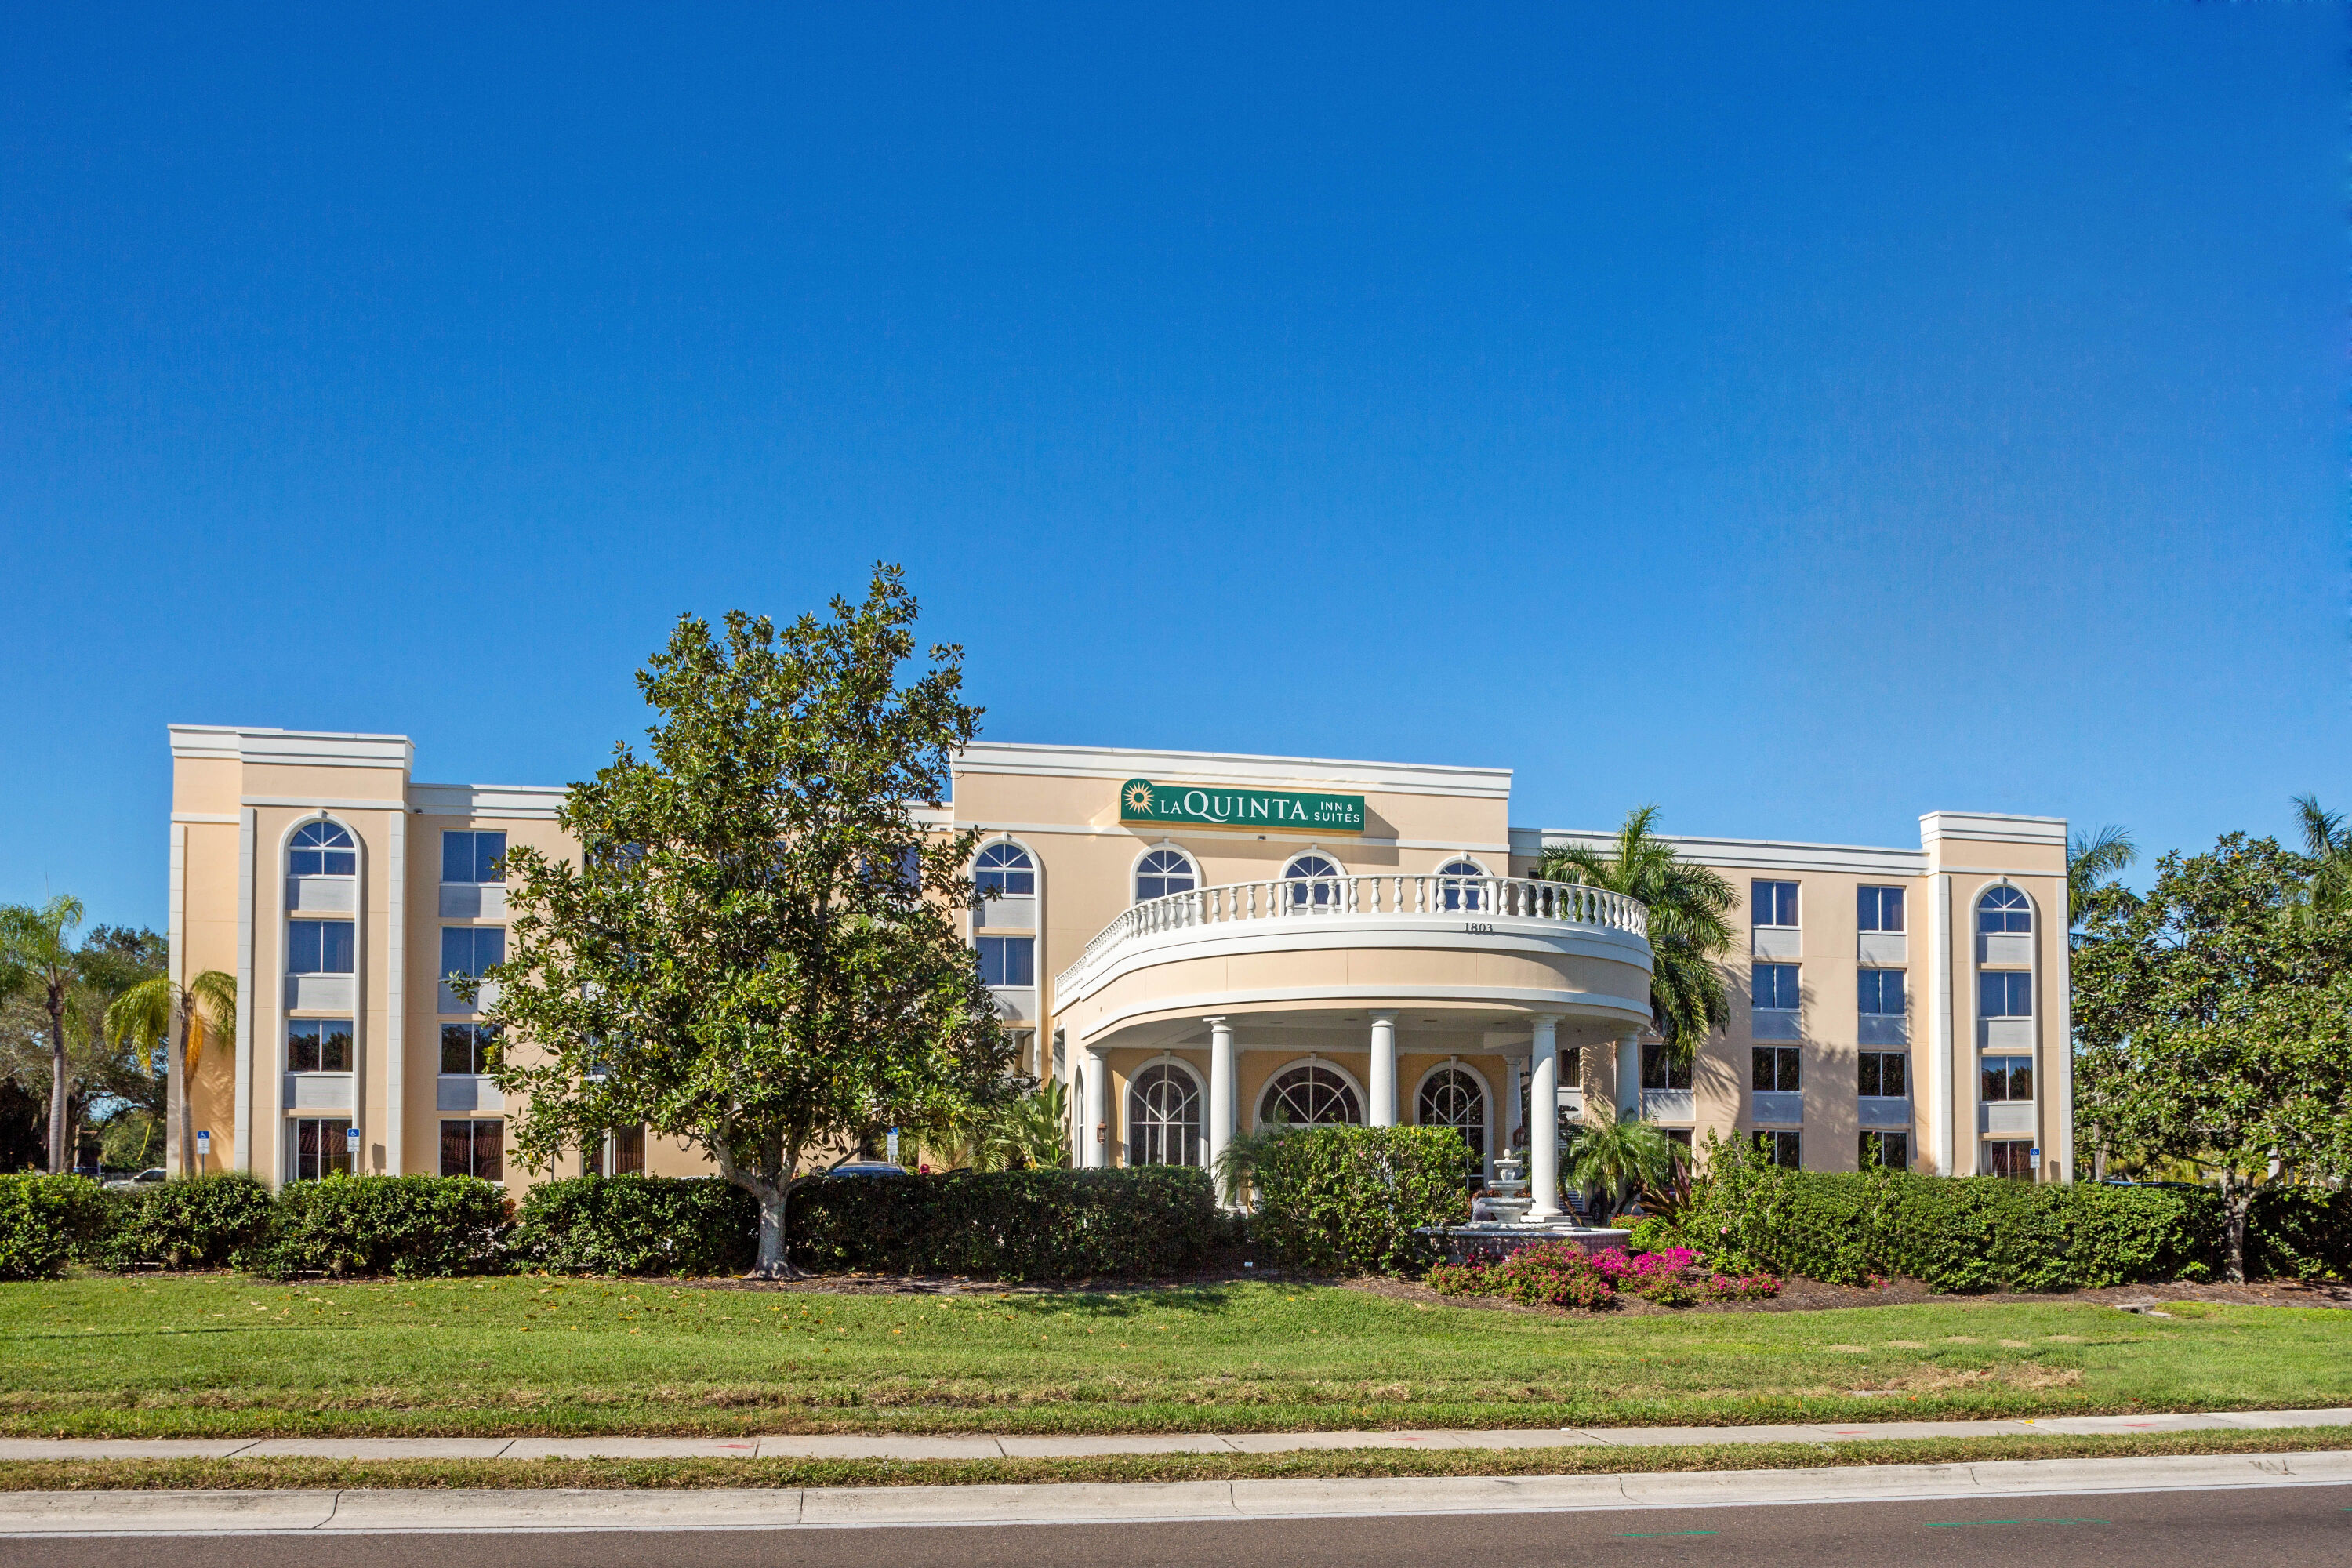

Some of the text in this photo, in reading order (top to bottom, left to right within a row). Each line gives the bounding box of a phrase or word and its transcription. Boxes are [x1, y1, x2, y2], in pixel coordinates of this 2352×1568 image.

[1160, 790, 1307, 823] LA QUINTA
[1320, 801, 1353, 812] INN &
[1314, 811, 1360, 823] SUITES
[1465, 922, 1494, 933] 1803
